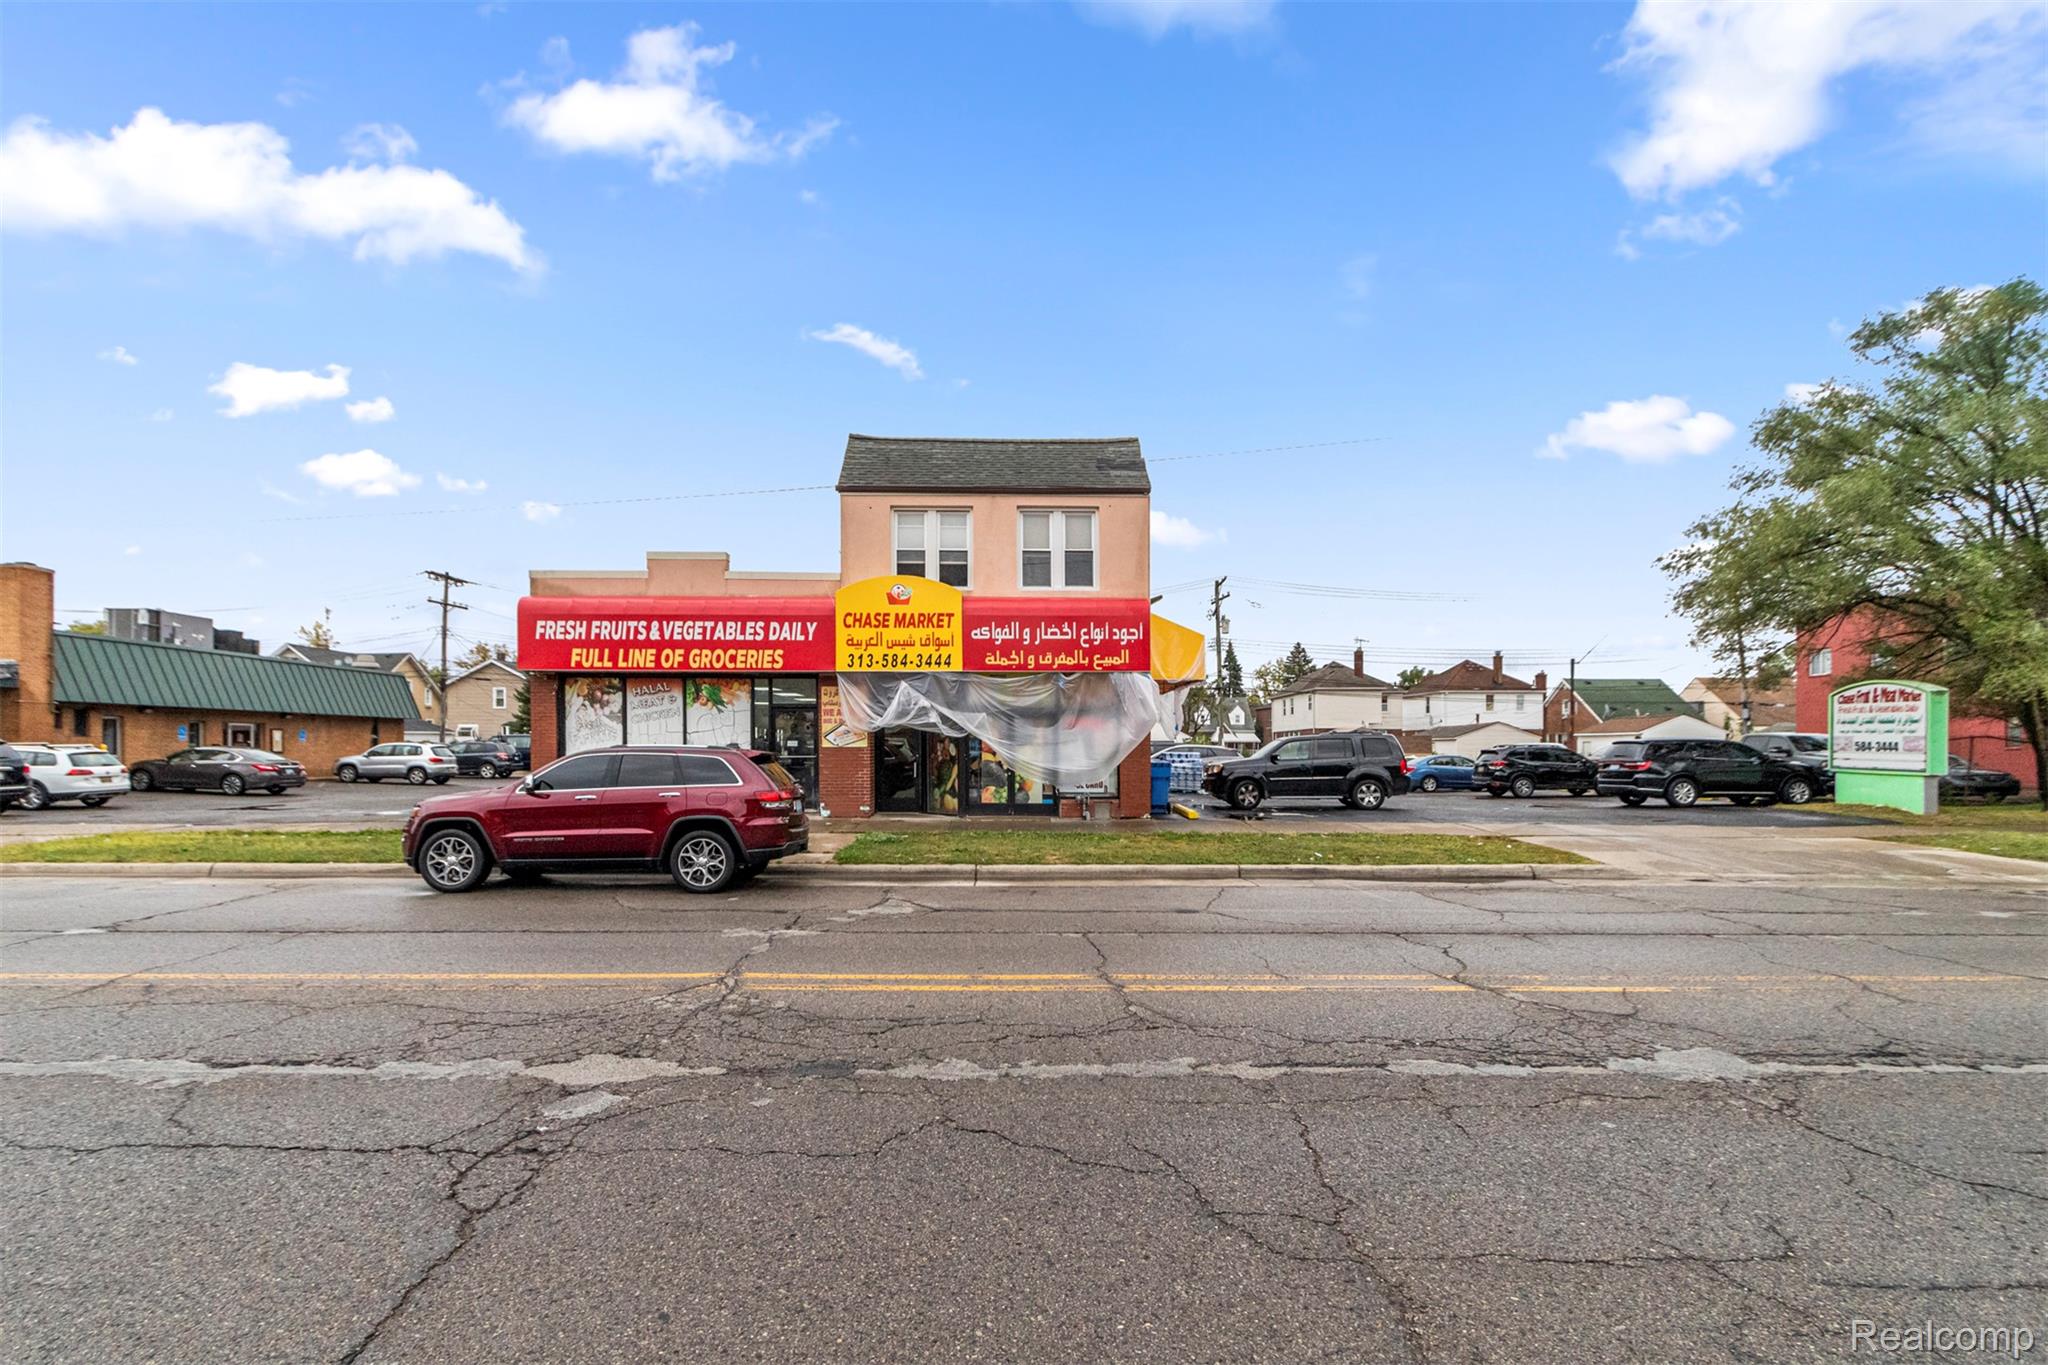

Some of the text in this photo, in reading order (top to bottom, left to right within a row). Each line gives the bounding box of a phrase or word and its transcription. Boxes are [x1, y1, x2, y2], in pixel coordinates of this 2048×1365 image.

[843, 612, 955, 629] CHASE MARKET
[535, 620, 586, 641] FRESH
[590, 620, 647, 641] FRUITS
[768, 621, 818, 641] DAILY
[570, 648, 784, 670] FULL LINE OF GROCERIES
[847, 653, 952, 668] 313-584-3444
[632, 682, 672, 698] HALAL
[1854, 741, 1899, 752] 584-3444
